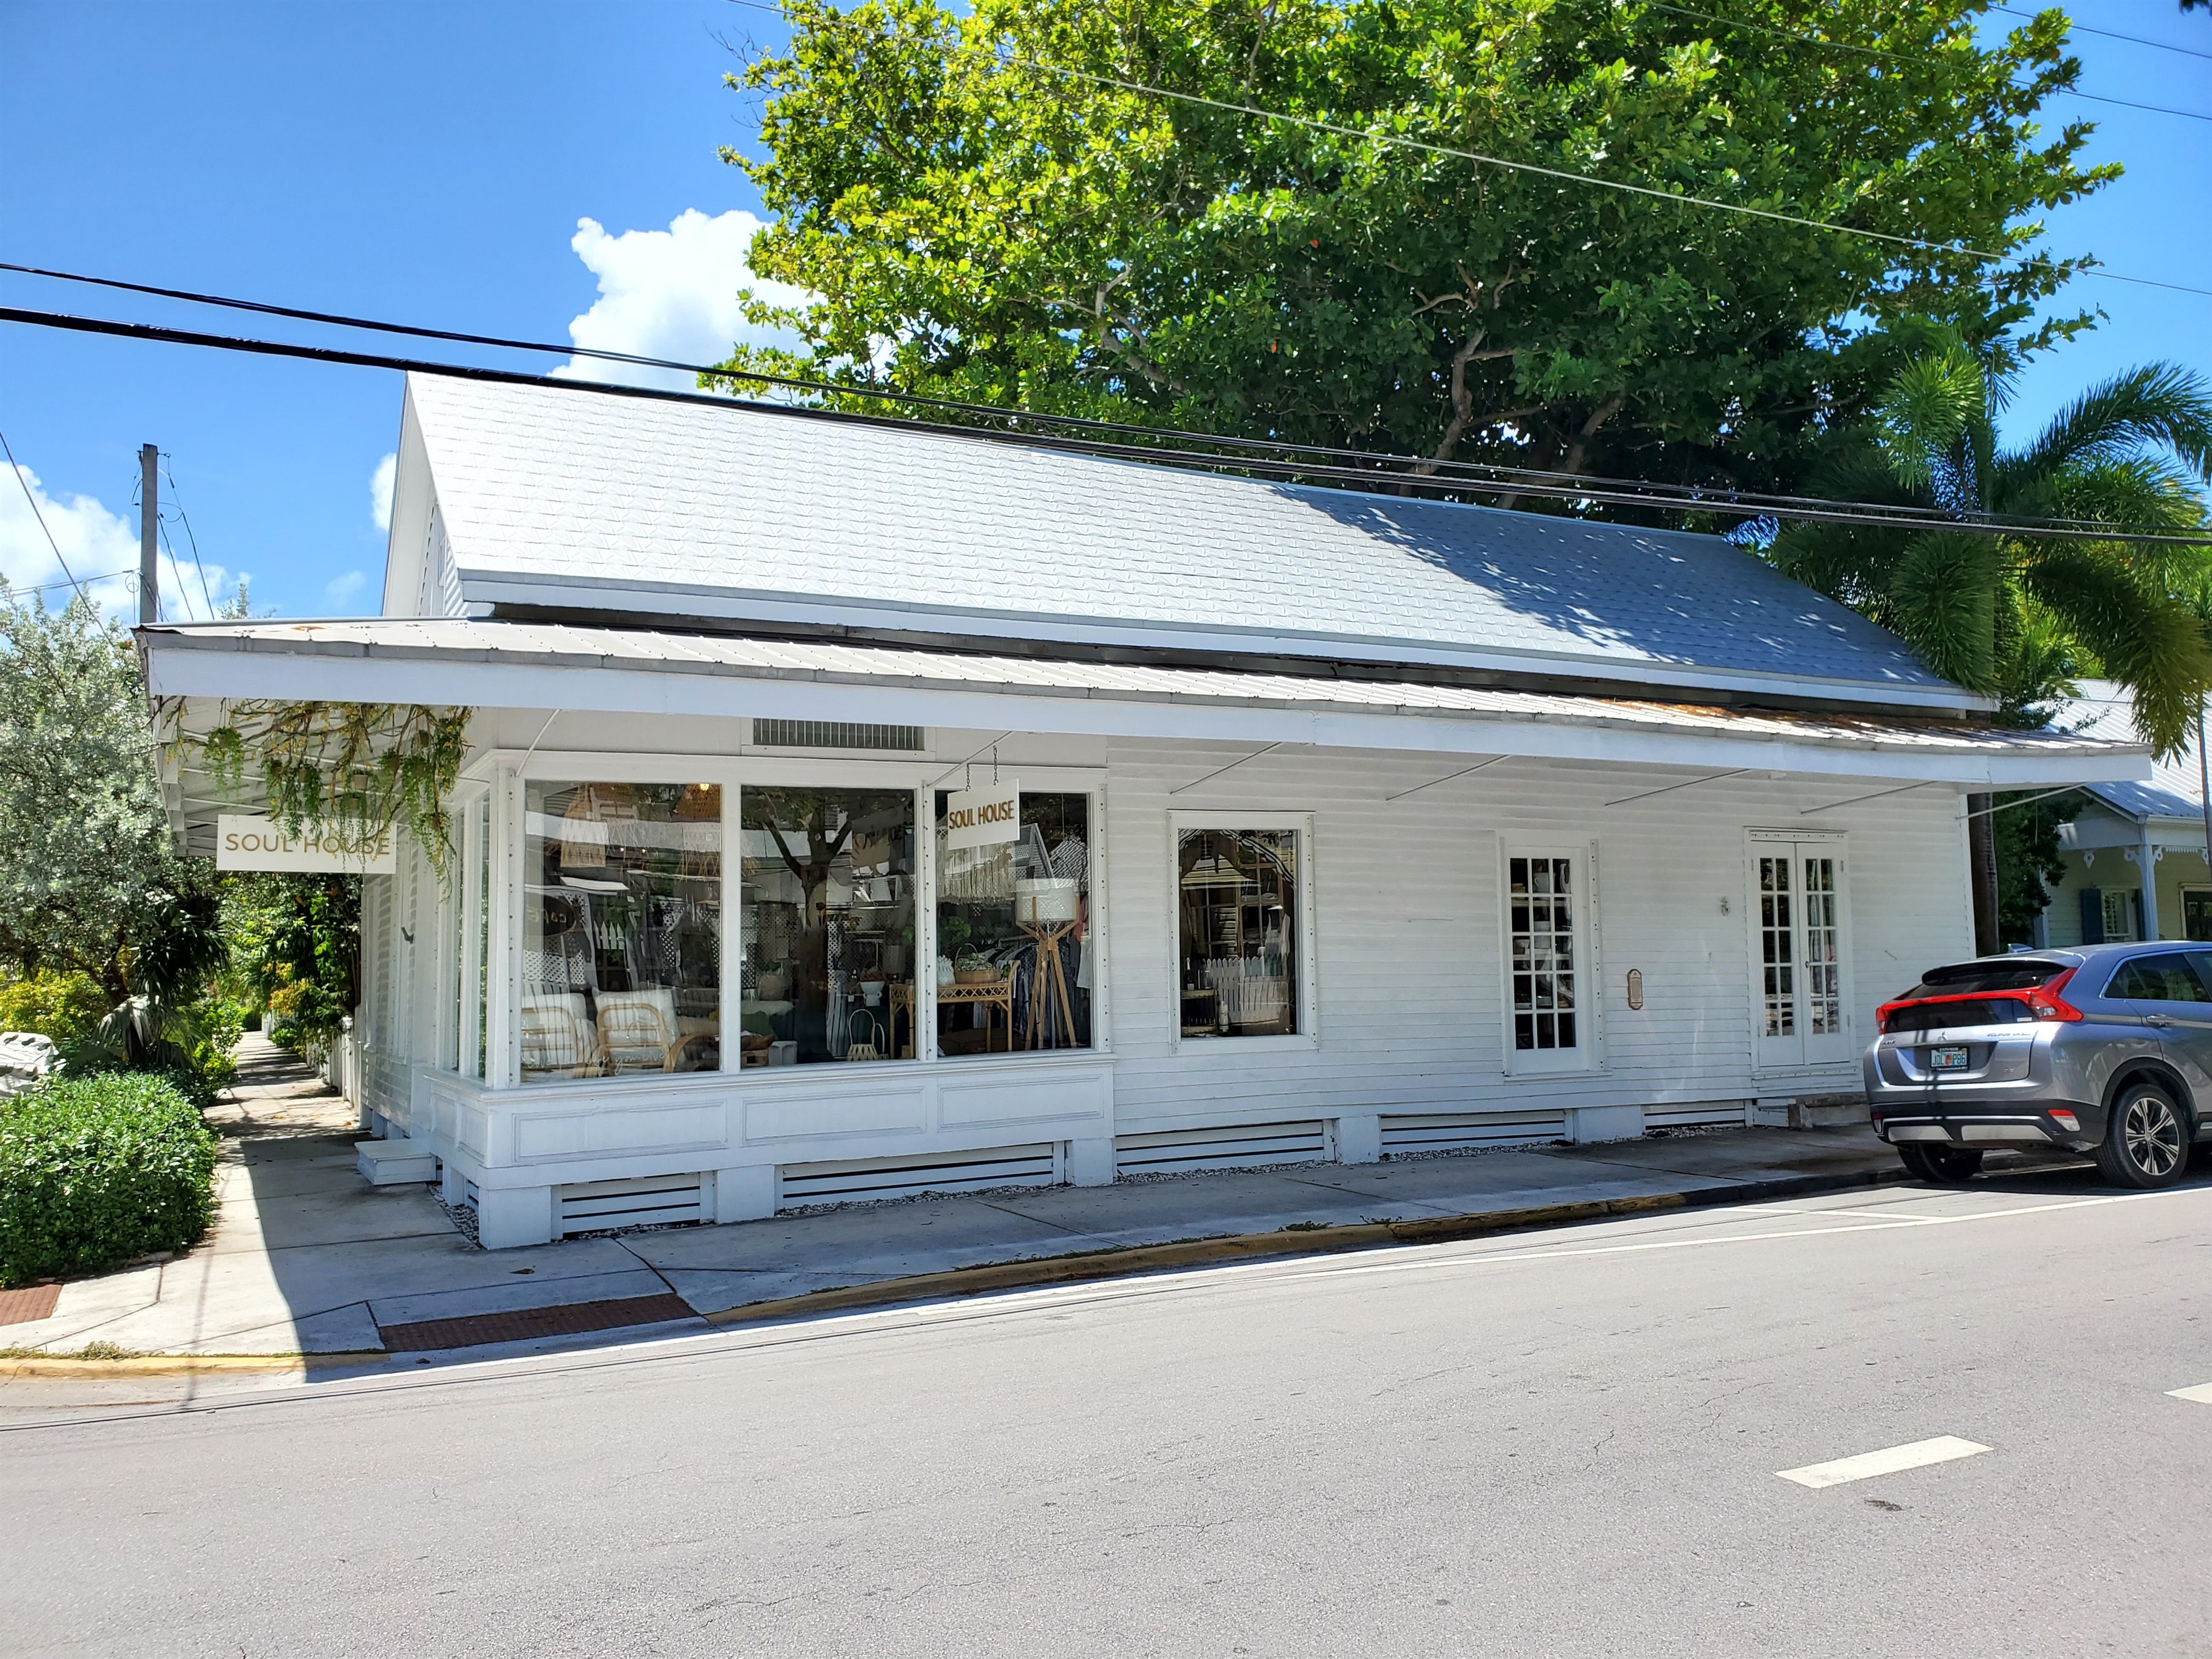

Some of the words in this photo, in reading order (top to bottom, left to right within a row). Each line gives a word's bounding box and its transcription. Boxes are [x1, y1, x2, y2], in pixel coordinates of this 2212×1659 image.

[949, 808, 976, 830] SOUL
[978, 800, 1014, 825] HOUSE
[225, 834, 293, 853] SOUL
[304, 835, 390, 855] HOUSE
